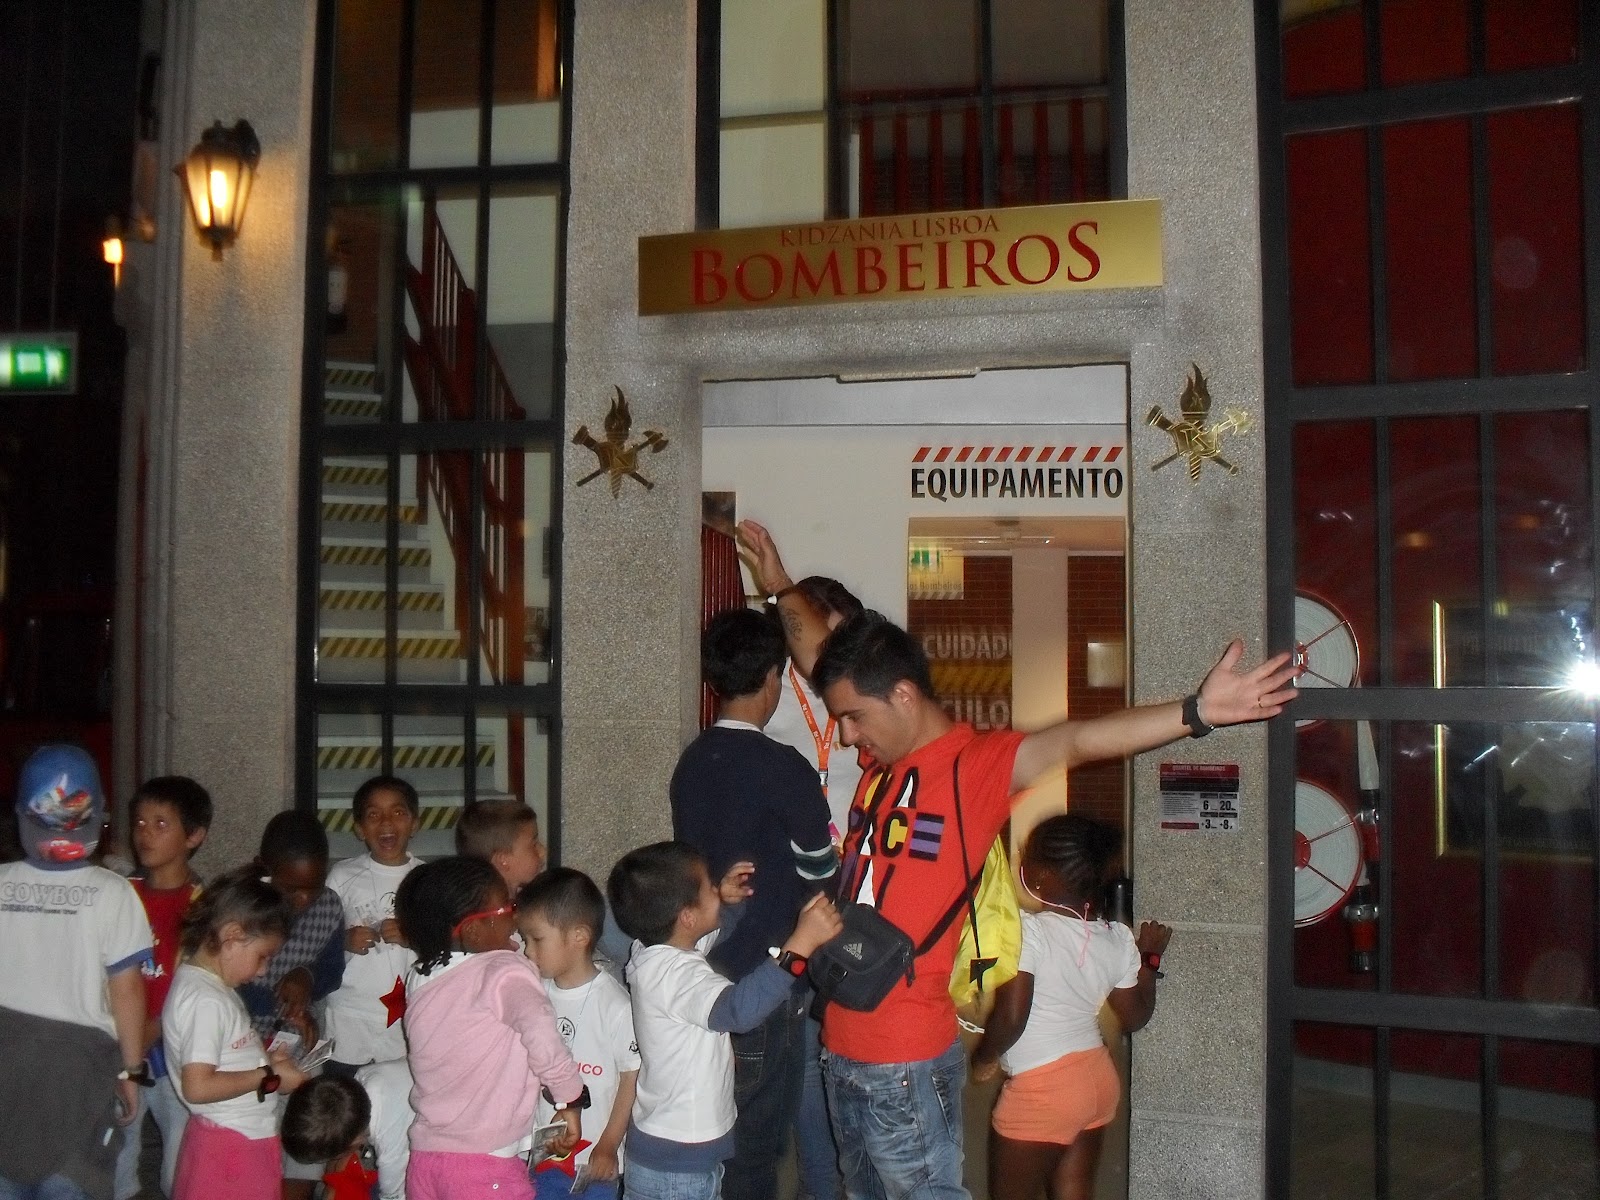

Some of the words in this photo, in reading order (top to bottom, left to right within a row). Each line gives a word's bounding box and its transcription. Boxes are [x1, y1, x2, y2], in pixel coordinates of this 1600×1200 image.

[781, 221, 905, 247] KIDZANIA
[912, 214, 1001, 239] LISBOA
[692, 221, 1101, 306] BOMBEIROS
[911, 468, 1124, 503] EQUIPAMENTO
[923, 634, 1012, 659] CUIDAD
[1203, 800, 1209, 810] 6
[1220, 800, 1232, 811] 20
[0, 882, 98, 907] COWBOY
